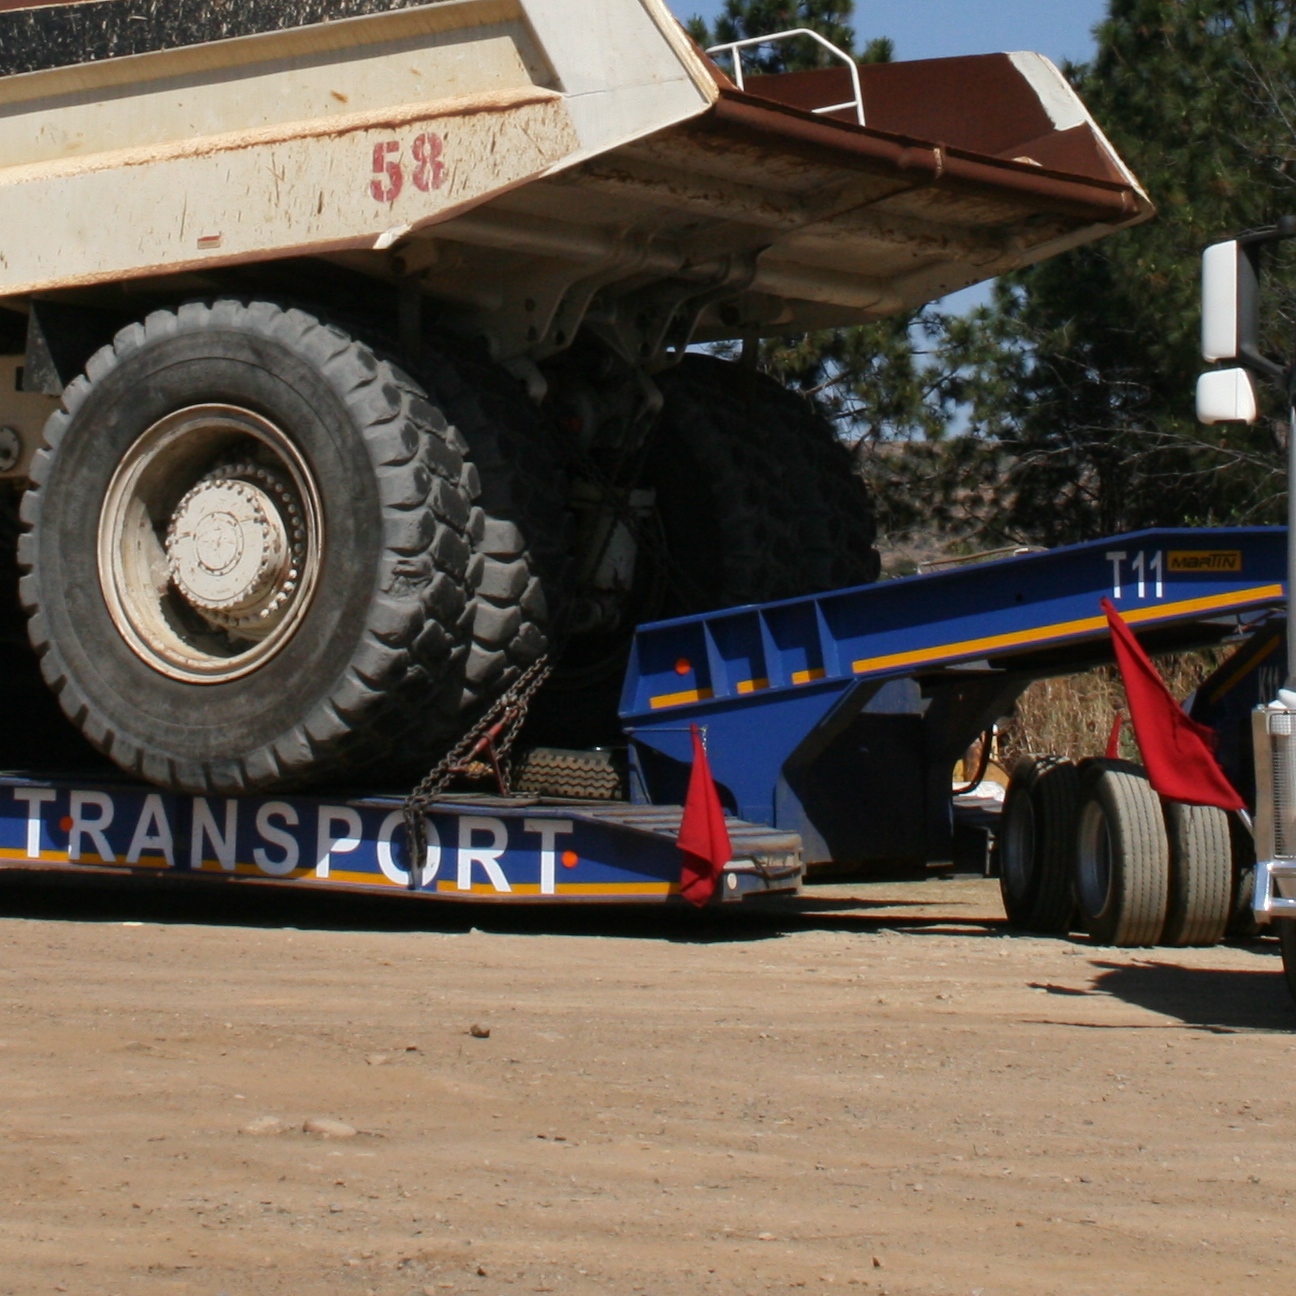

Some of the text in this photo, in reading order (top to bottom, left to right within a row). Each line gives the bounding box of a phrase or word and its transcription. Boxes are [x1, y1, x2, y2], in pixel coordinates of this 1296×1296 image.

[370, 133, 448, 202] 58
[1106, 550, 1163, 598] T11
[14, 789, 574, 894] TRANSPORT
